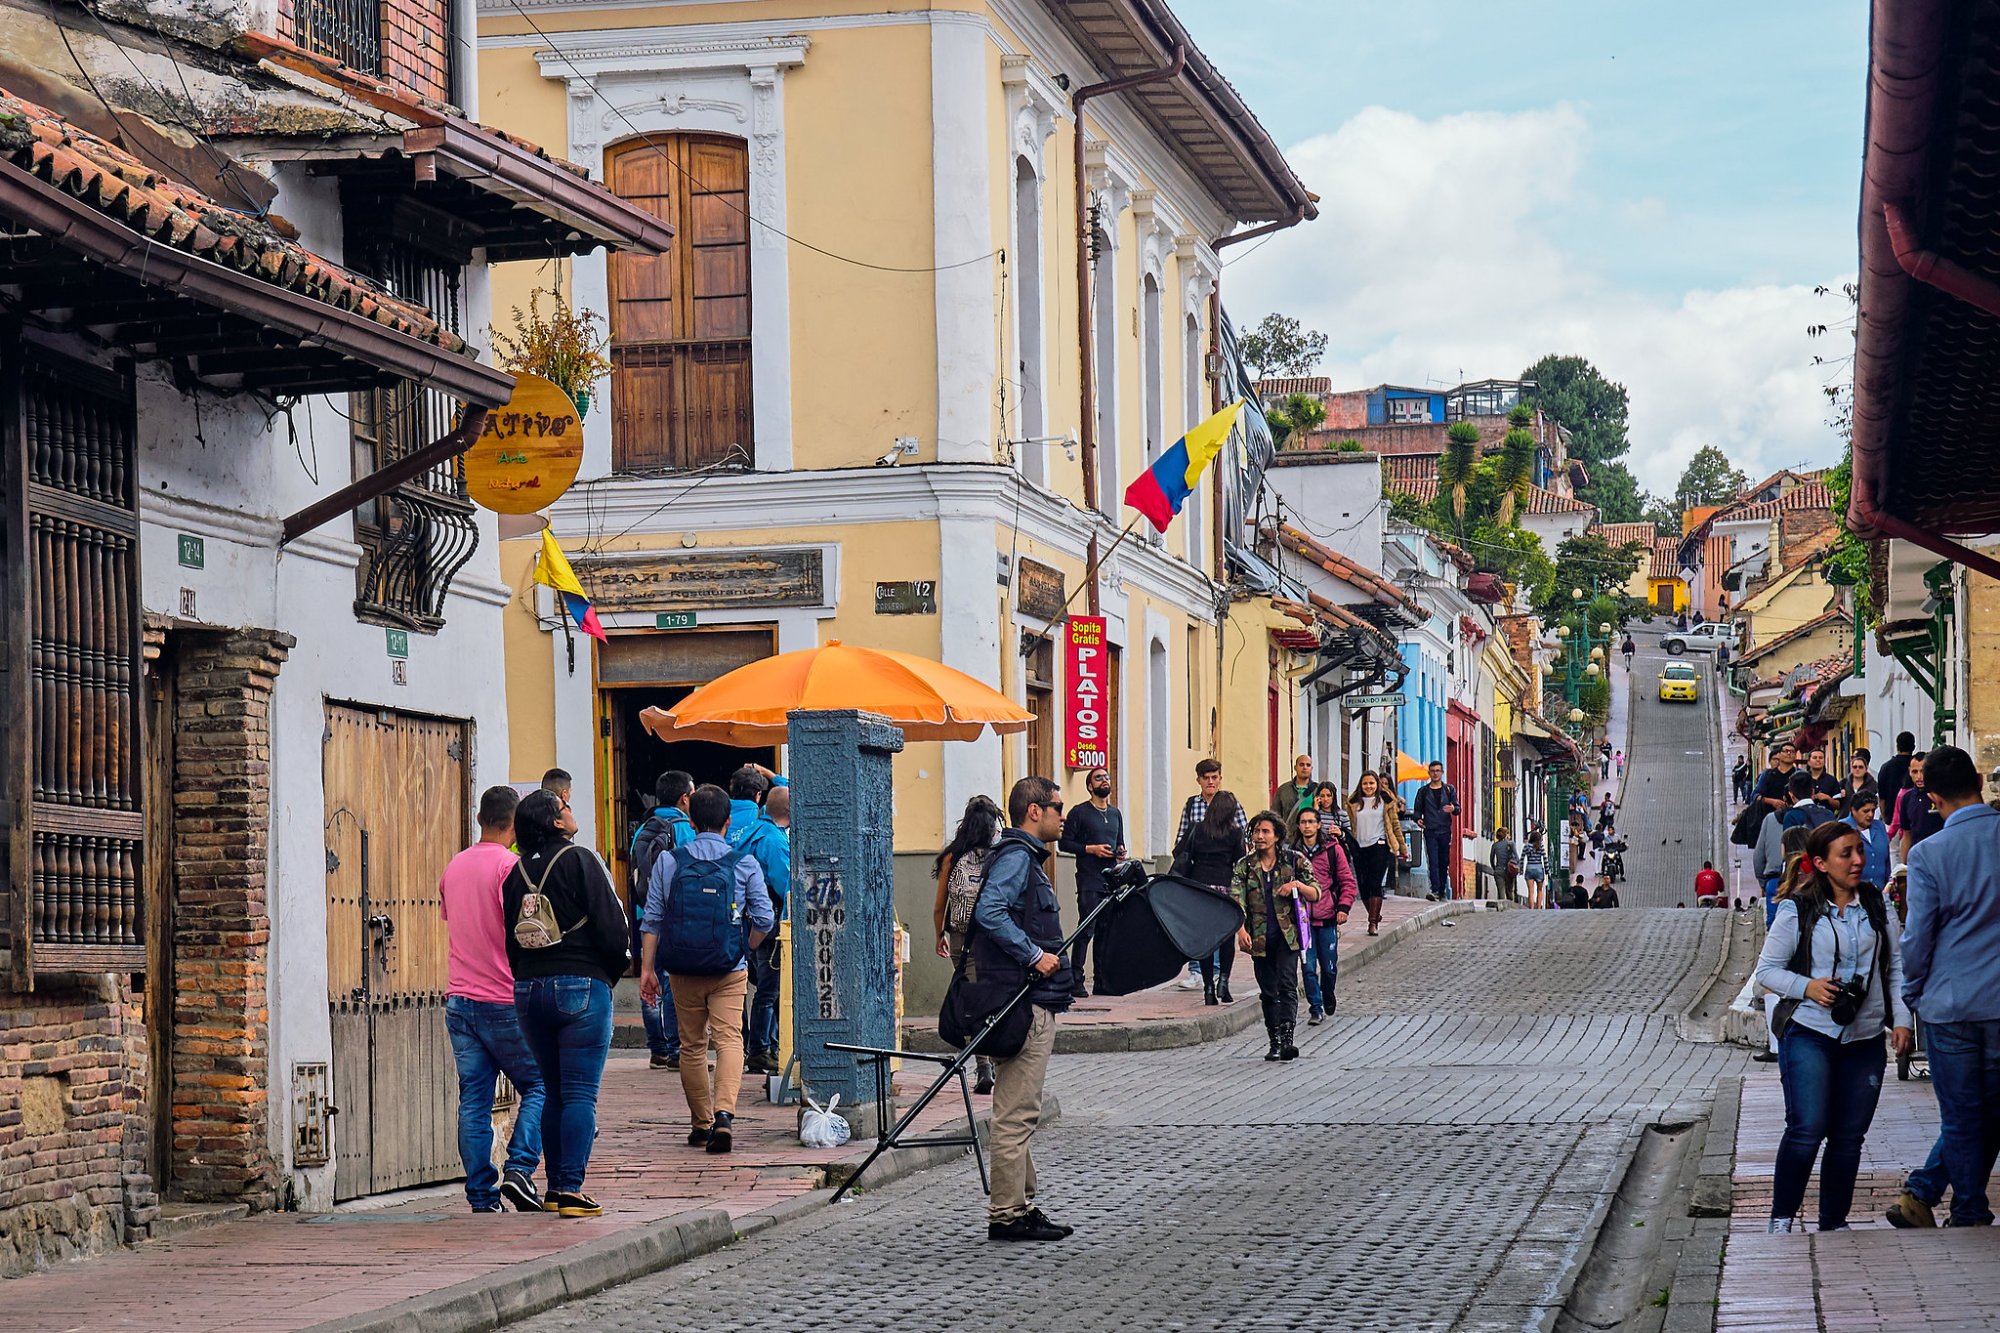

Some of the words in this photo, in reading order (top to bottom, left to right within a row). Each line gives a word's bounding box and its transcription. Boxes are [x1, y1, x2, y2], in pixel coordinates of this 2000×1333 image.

[497, 451, 529, 464] Arte
[922, 602, 928, 613] 2
[666, 615, 688, 626] 1-79
[1072, 621, 1101, 634] Sopita
[1072, 633, 1100, 645] Gratis
[1076, 647, 1099, 739] PLATOS
[1077, 741, 1097, 750] Desde
